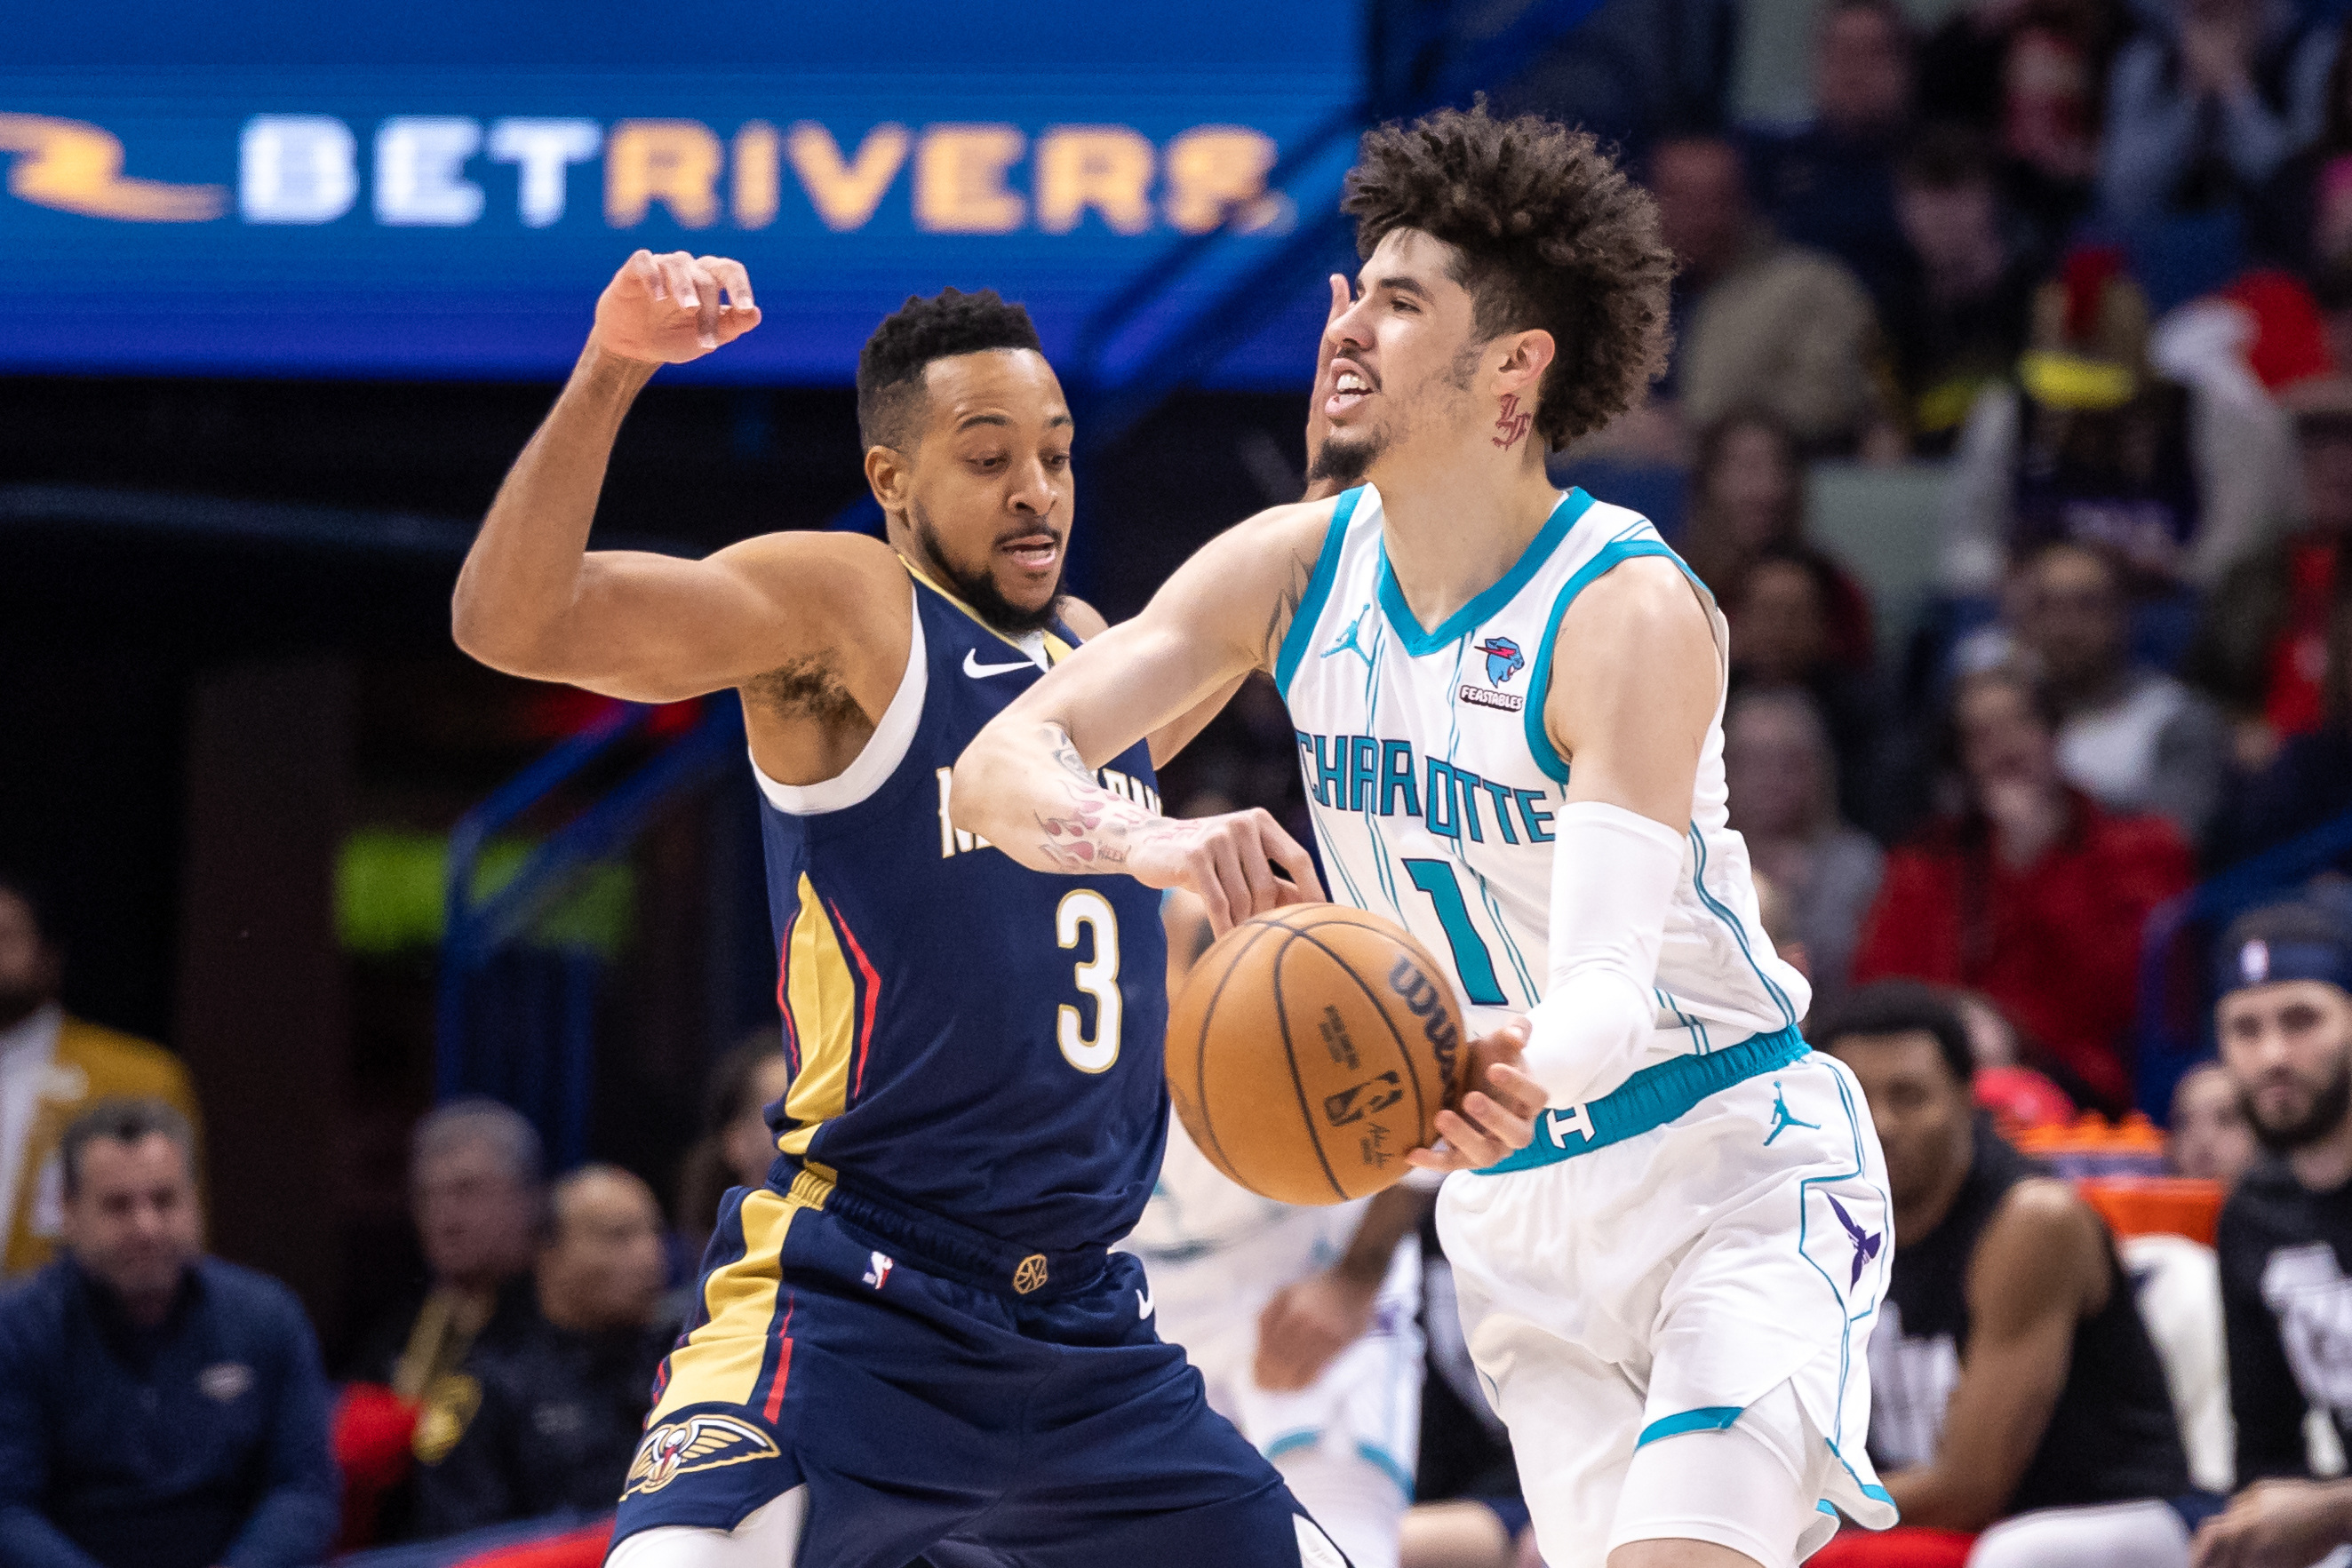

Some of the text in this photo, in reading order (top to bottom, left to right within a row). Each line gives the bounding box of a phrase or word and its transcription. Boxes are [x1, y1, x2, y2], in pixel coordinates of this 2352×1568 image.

[1460, 685, 1523, 712] FEASTABLES
[1296, 729, 1556, 845] CHAROTTE
[1056, 888, 1123, 1074] 3
[1401, 857, 1510, 1007] 1
